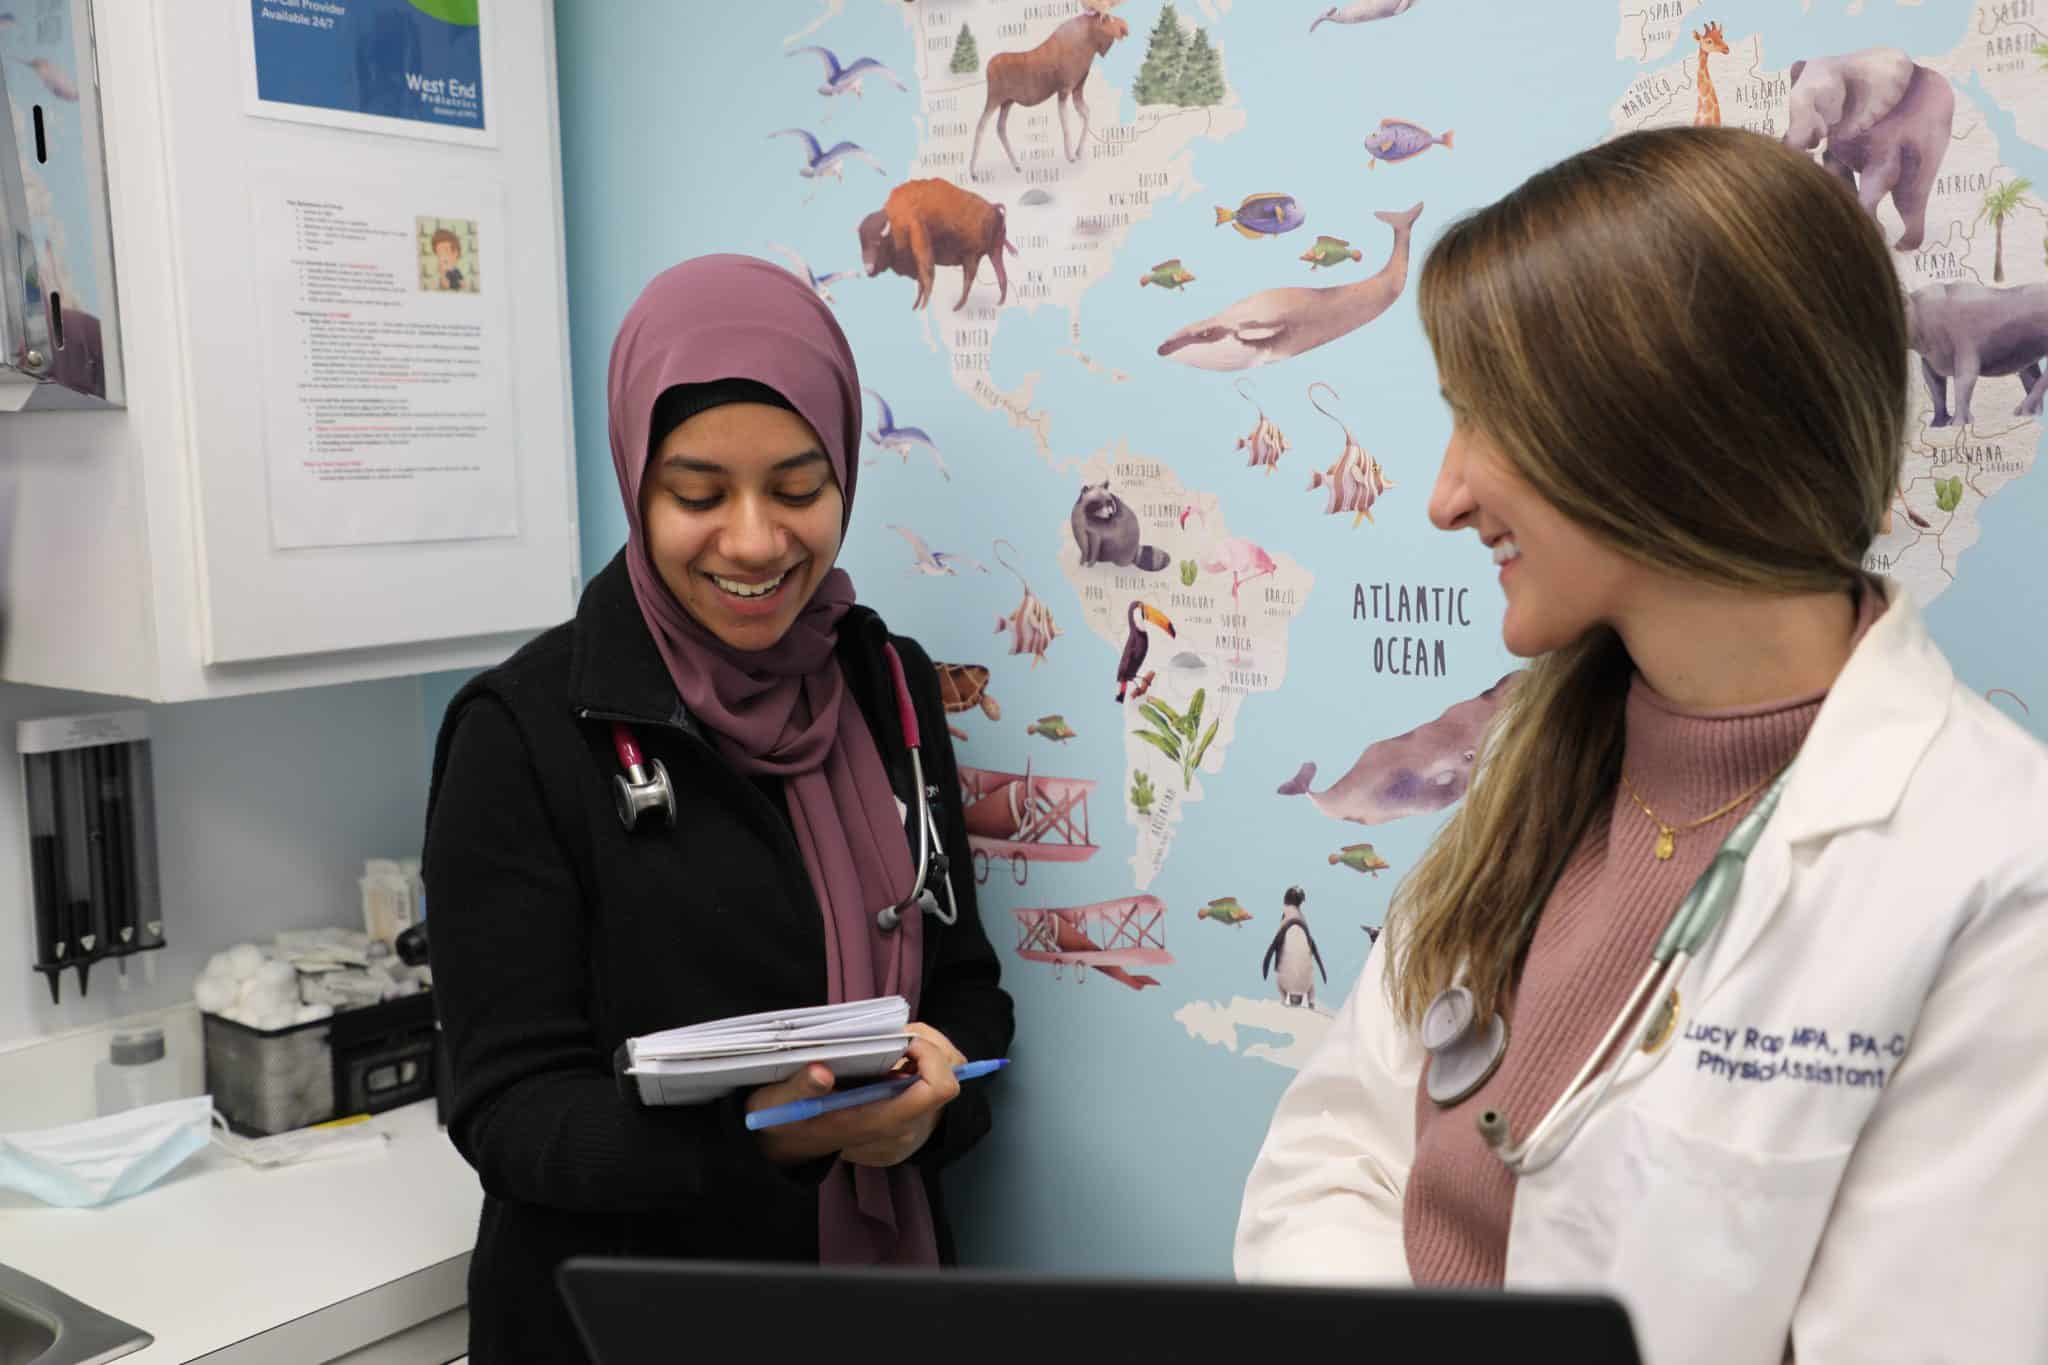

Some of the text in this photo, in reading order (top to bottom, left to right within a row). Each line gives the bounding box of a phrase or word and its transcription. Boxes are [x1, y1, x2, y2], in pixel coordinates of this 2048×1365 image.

[262, 7, 334, 29] Available 24/7
[302, 0, 345, 15] Provider
[1649, 0, 1682, 21] SPAIN
[1992, 0, 2034, 20] SAUDI
[1986, 33, 2037, 57] ARABIA
[405, 72, 476, 98] West End
[421, 93, 478, 109] Pediatrics
[1622, 79, 1671, 118] MAROCCO
[1139, 172, 1167, 188] BOSTON
[1937, 173, 1985, 195] AFRICA
[1053, 264, 1087, 280] ATLANTA
[1914, 252, 1956, 273] KENYA
[955, 328, 989, 347] UNITED
[954, 351, 989, 369] STATES
[1933, 445, 2002, 465] BOTSWANA
[1171, 593, 1215, 609] PARAGUAY
[1265, 588, 1295, 604] BRAZIL
[1353, 582, 1471, 627] ATLANTIC
[1374, 637, 1446, 677] OCEAN
[1683, 1019, 1737, 1051] Lucy
[1848, 1031, 1905, 1057] PA-C
[1780, 1056, 1886, 1089] Assistant
